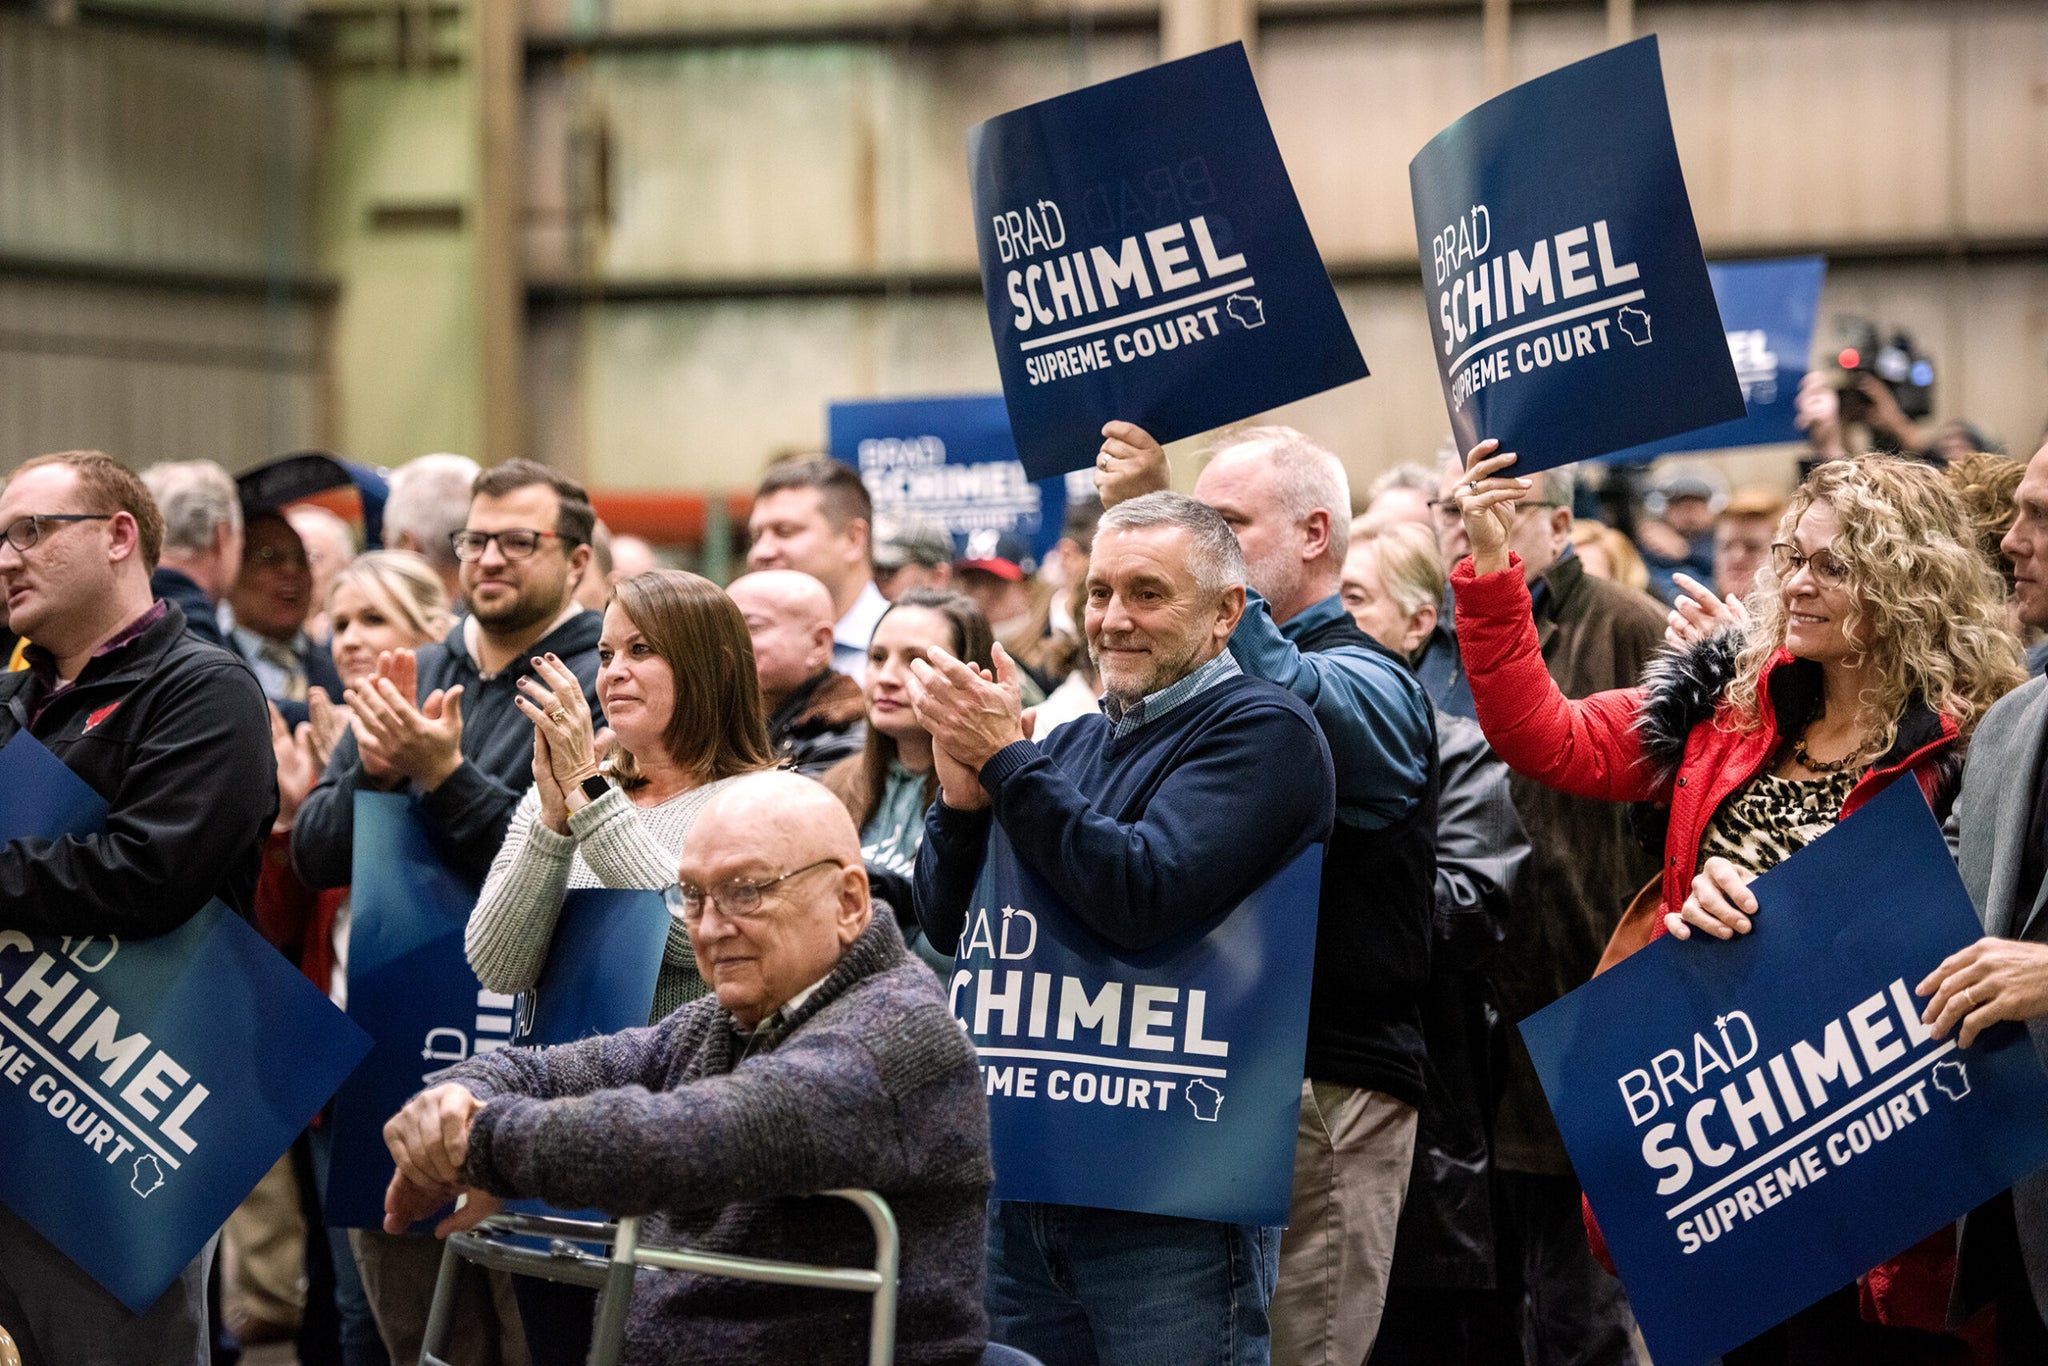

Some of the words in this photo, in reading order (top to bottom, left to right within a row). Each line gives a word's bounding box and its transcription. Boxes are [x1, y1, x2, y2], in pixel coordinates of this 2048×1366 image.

[994, 200, 1066, 263] BRAD
[1007, 216, 1247, 331] SCHIMEL
[1433, 205, 1490, 287] BRAD
[1440, 220, 1640, 356] SCHIMEL
[1026, 340, 1111, 385] SUPREME
[1114, 307, 1220, 362] COURT
[1516, 318, 1611, 373] COURT
[954, 904, 1038, 960] RAD
[0, 929, 210, 1155] CHIMEL
[949, 969, 1229, 1056] CHIMEL
[1047, 1071, 1177, 1110] COURT
[1617, 1010, 1759, 1127] BRAD
[1641, 977, 1934, 1195] SCHIMEL
[29, 1075, 135, 1164] COURT
[1676, 1147, 1827, 1254] SUPREME
[1826, 1081, 1931, 1167] COURT
